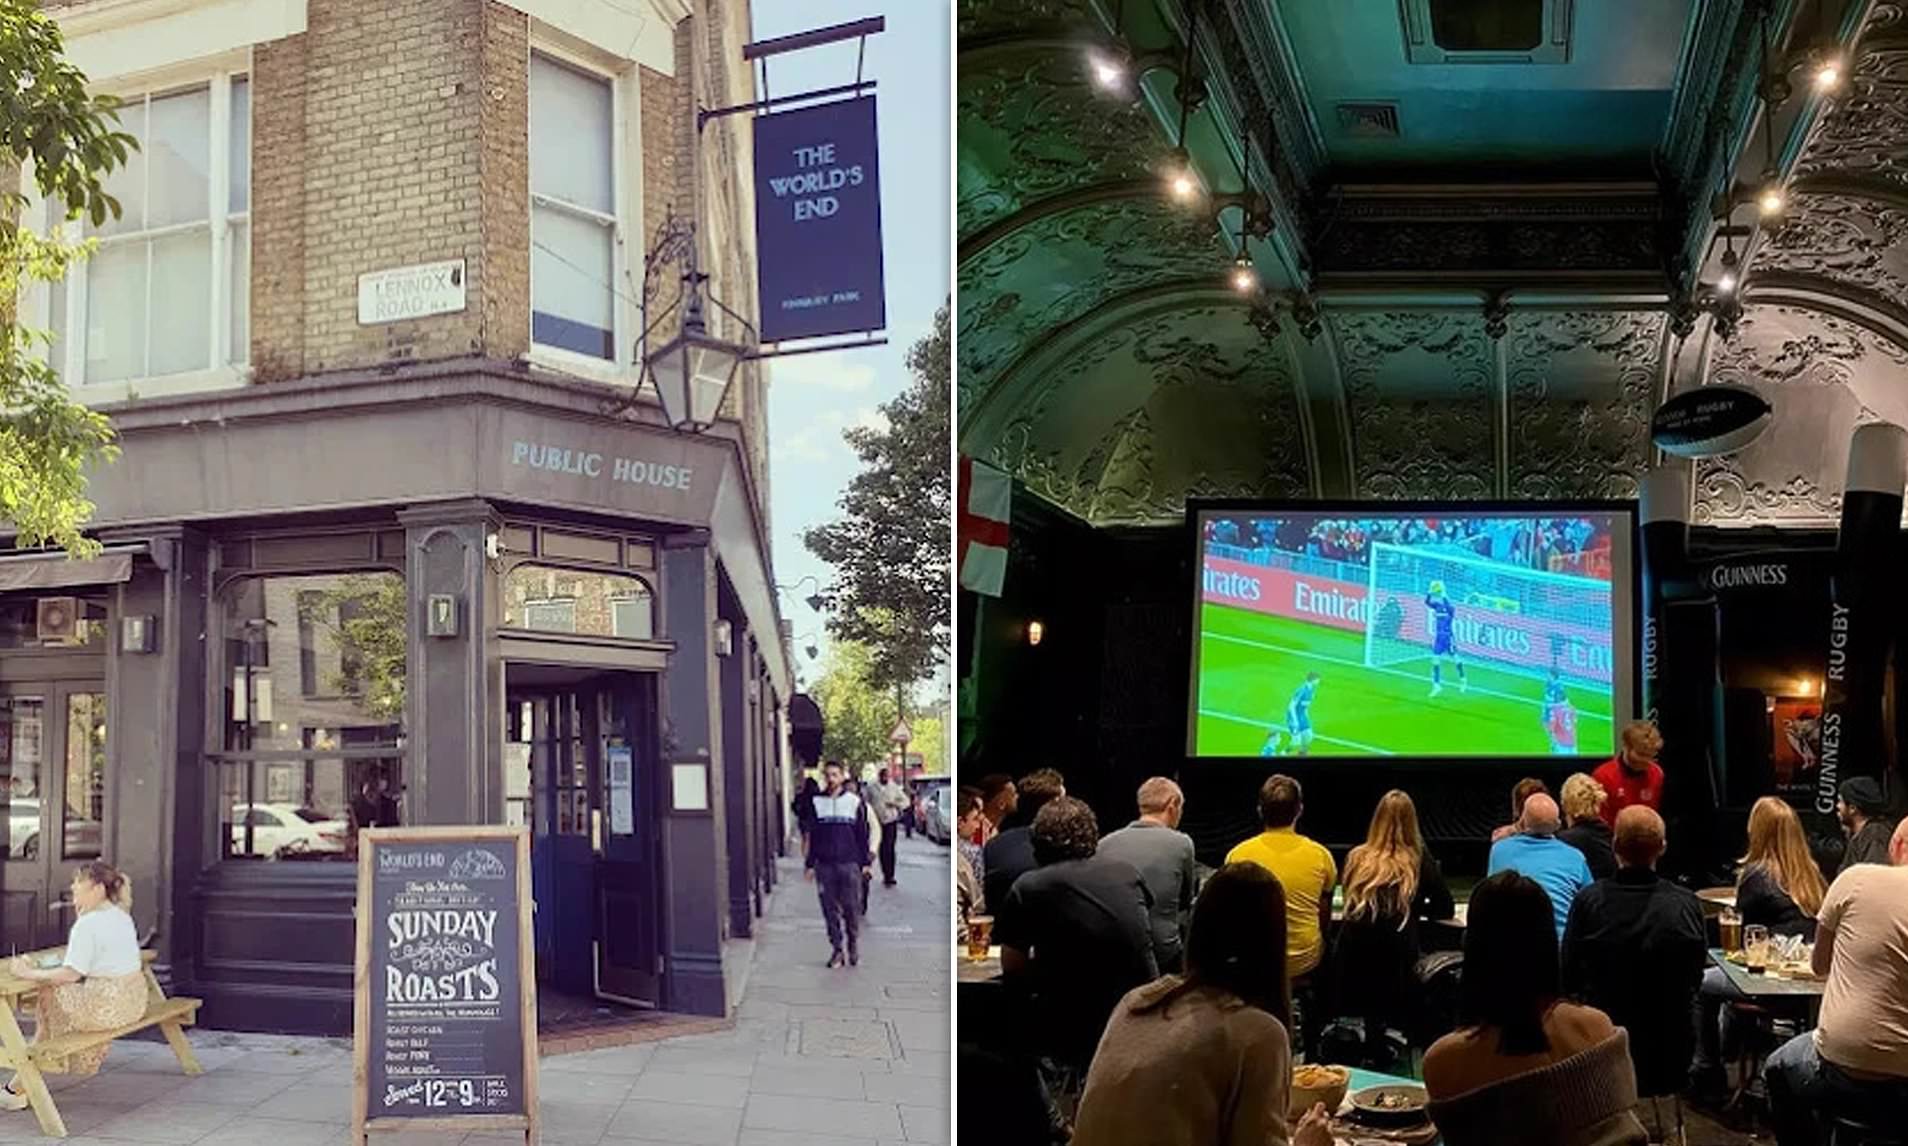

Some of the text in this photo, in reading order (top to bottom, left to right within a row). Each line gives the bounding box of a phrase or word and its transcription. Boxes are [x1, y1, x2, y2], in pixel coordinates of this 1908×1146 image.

[793, 144, 836, 168] THE
[769, 165, 864, 198] WORLD'S
[794, 196, 840, 221] END
[375, 272, 447, 298] LENNOX
[375, 296, 423, 319] ROAD
[512, 441, 692, 490] PUBLIC HOUSE
[1712, 564, 1788, 588] GUINNESS
[1814, 602, 1849, 814] GUINNESS RUGBY
[387, 910, 497, 949] SUNDAY
[386, 958, 499, 1001] ROASTS
[424, 1080, 447, 1106] 12
[460, 1080, 473, 1106] 9
